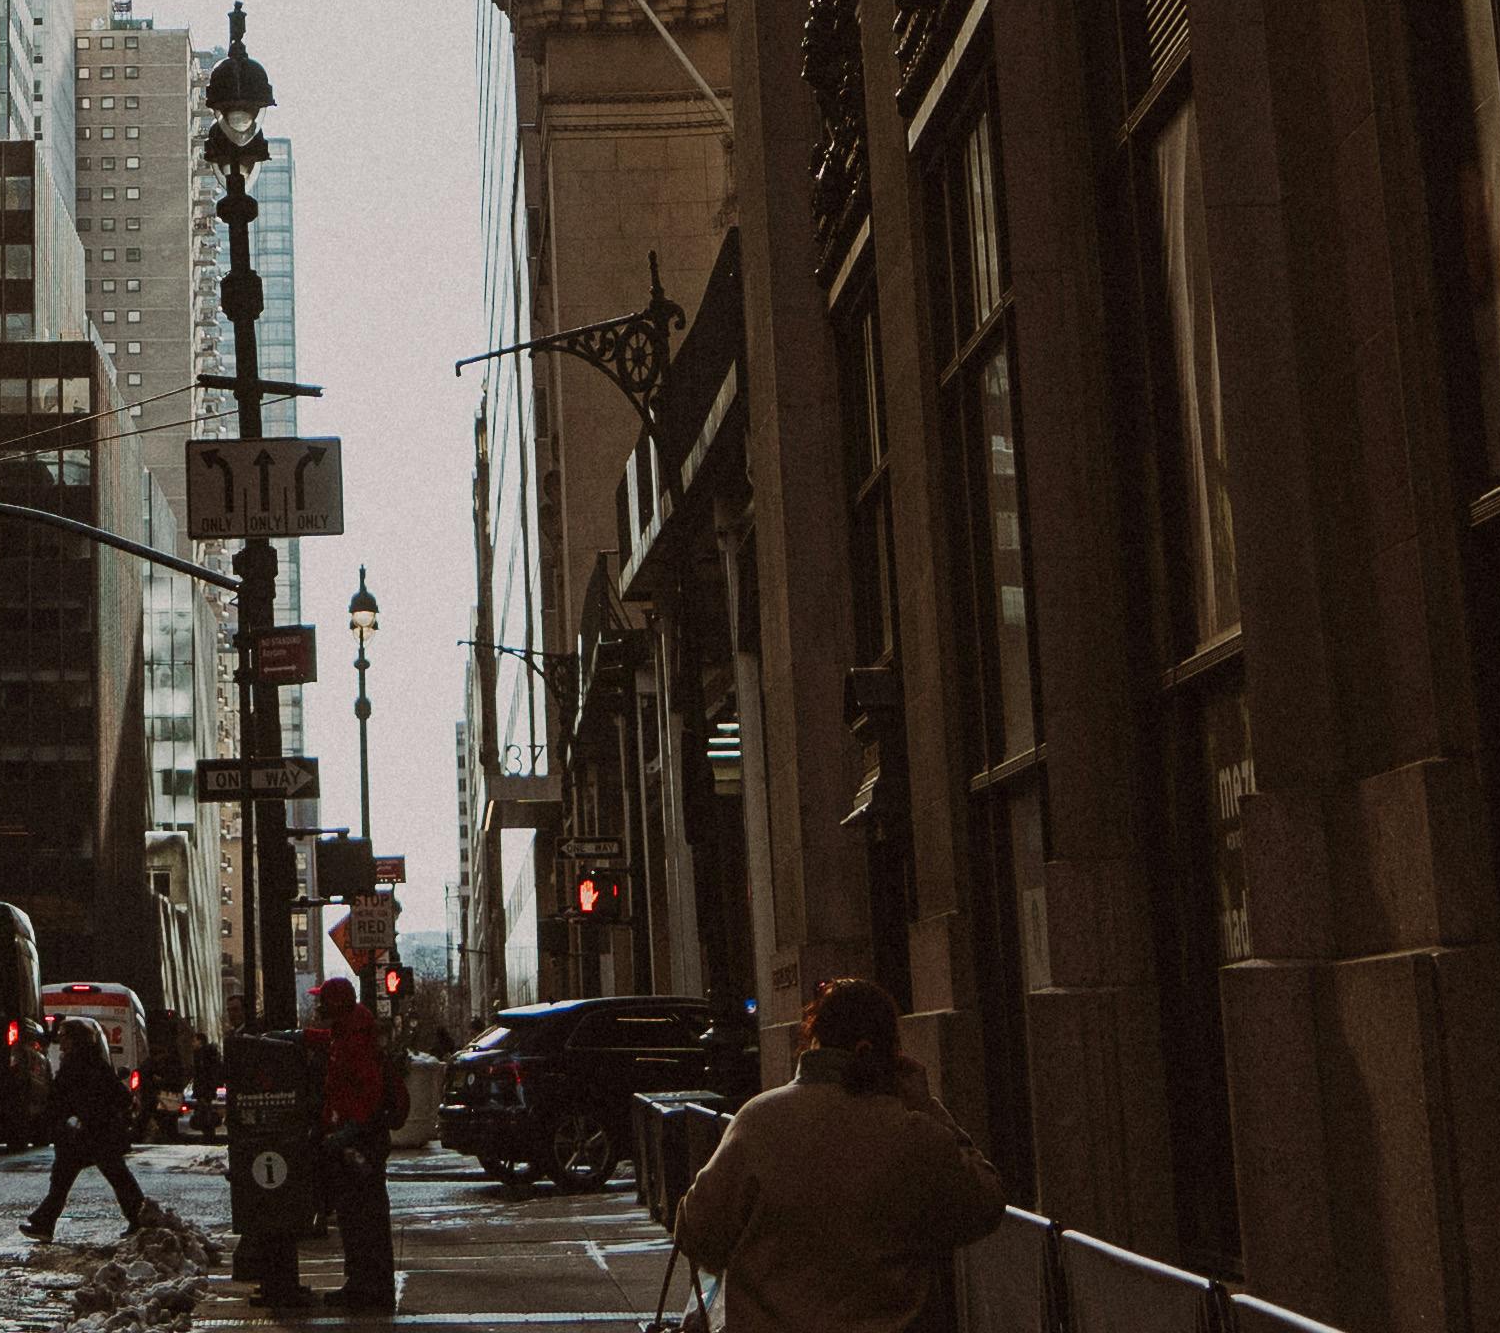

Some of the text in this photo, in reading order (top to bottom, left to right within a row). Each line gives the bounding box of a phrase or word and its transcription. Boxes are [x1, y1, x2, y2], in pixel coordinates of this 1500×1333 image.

[201, 517, 233, 532] ONLY
[250, 516, 281, 531] ONLY
[297, 515, 329, 529] ONLY
[215, 769, 301, 788] ON WAY
[594, 841, 614, 853] WAY
[354, 894, 390, 908] STOP
[357, 920, 387, 934] RED
